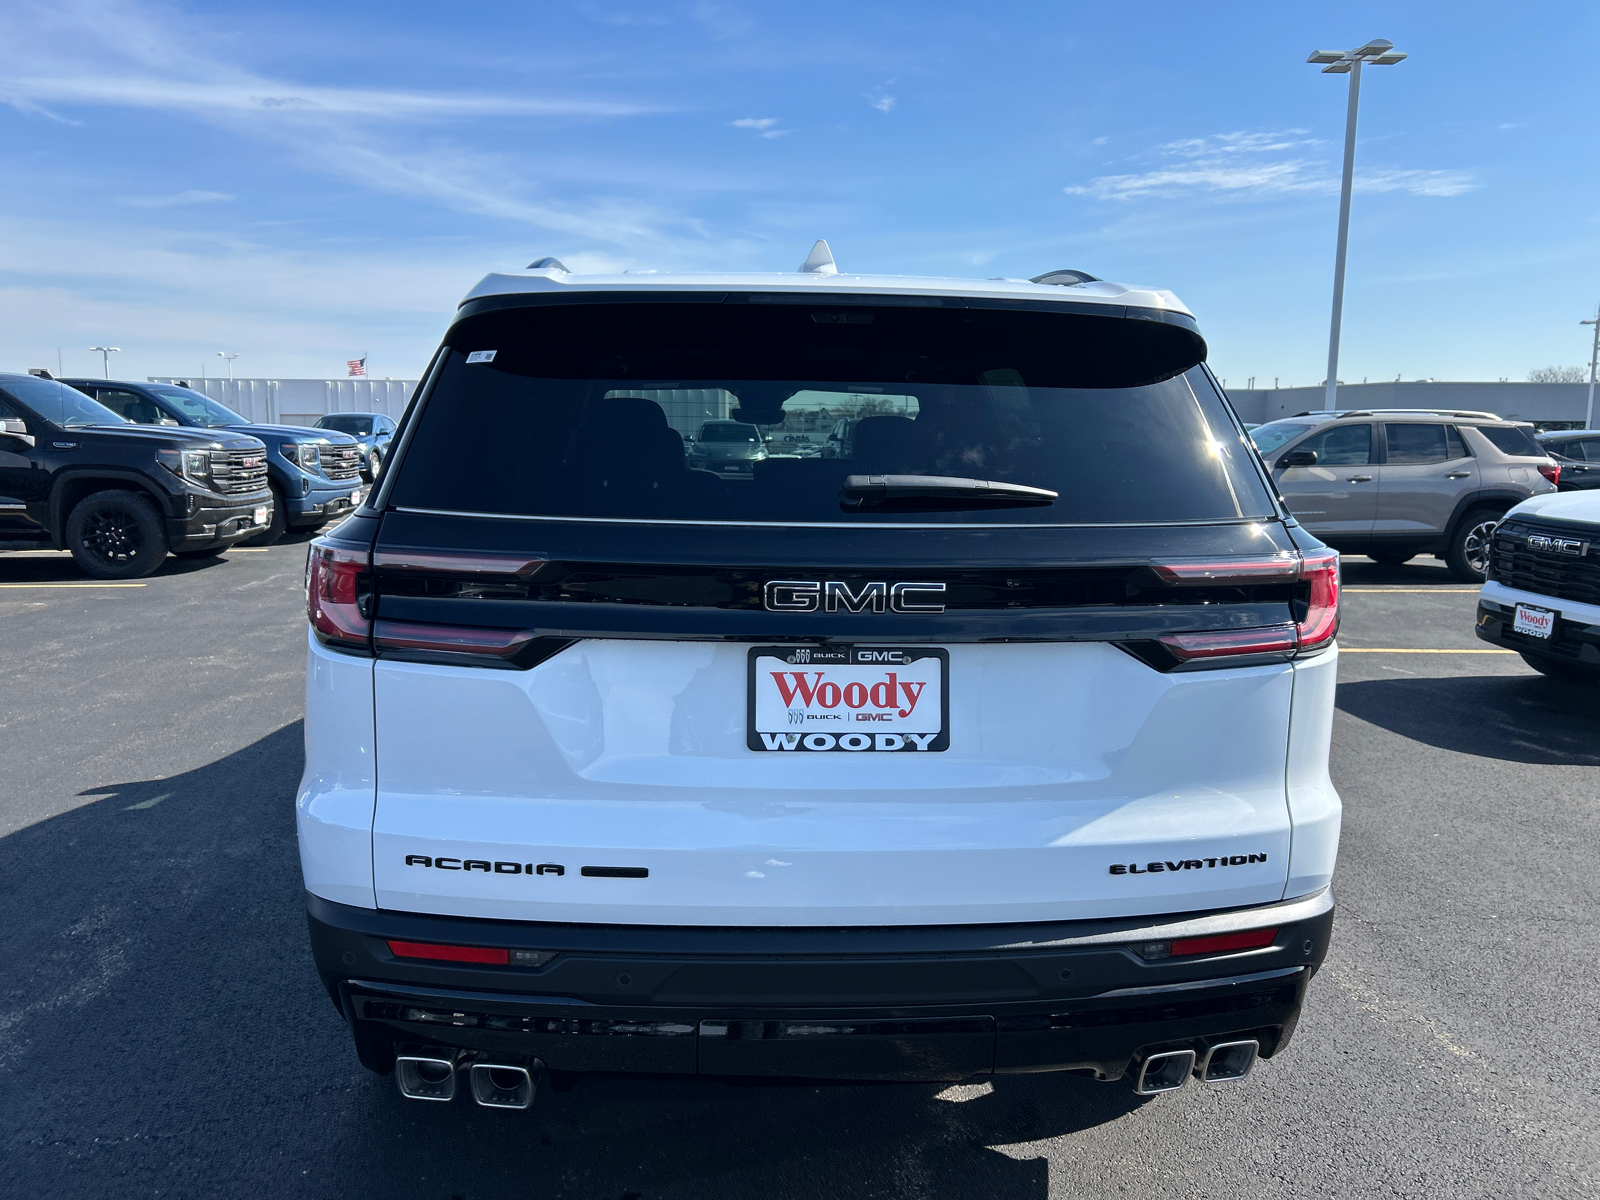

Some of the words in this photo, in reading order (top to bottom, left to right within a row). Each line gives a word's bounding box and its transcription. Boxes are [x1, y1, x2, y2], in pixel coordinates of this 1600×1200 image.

[1527, 534, 1582, 557] GMC
[764, 580, 946, 613] GMC
[1519, 609, 1551, 629] Woody
[1514, 626, 1551, 640] WOODY
[857, 651, 903, 662] GMC
[769, 671, 927, 718] Woody
[855, 713, 893, 722] GMC
[759, 733, 938, 751] WOODY
[405, 854, 565, 877] ACADIA
[1109, 852, 1268, 875] ELEVATION
